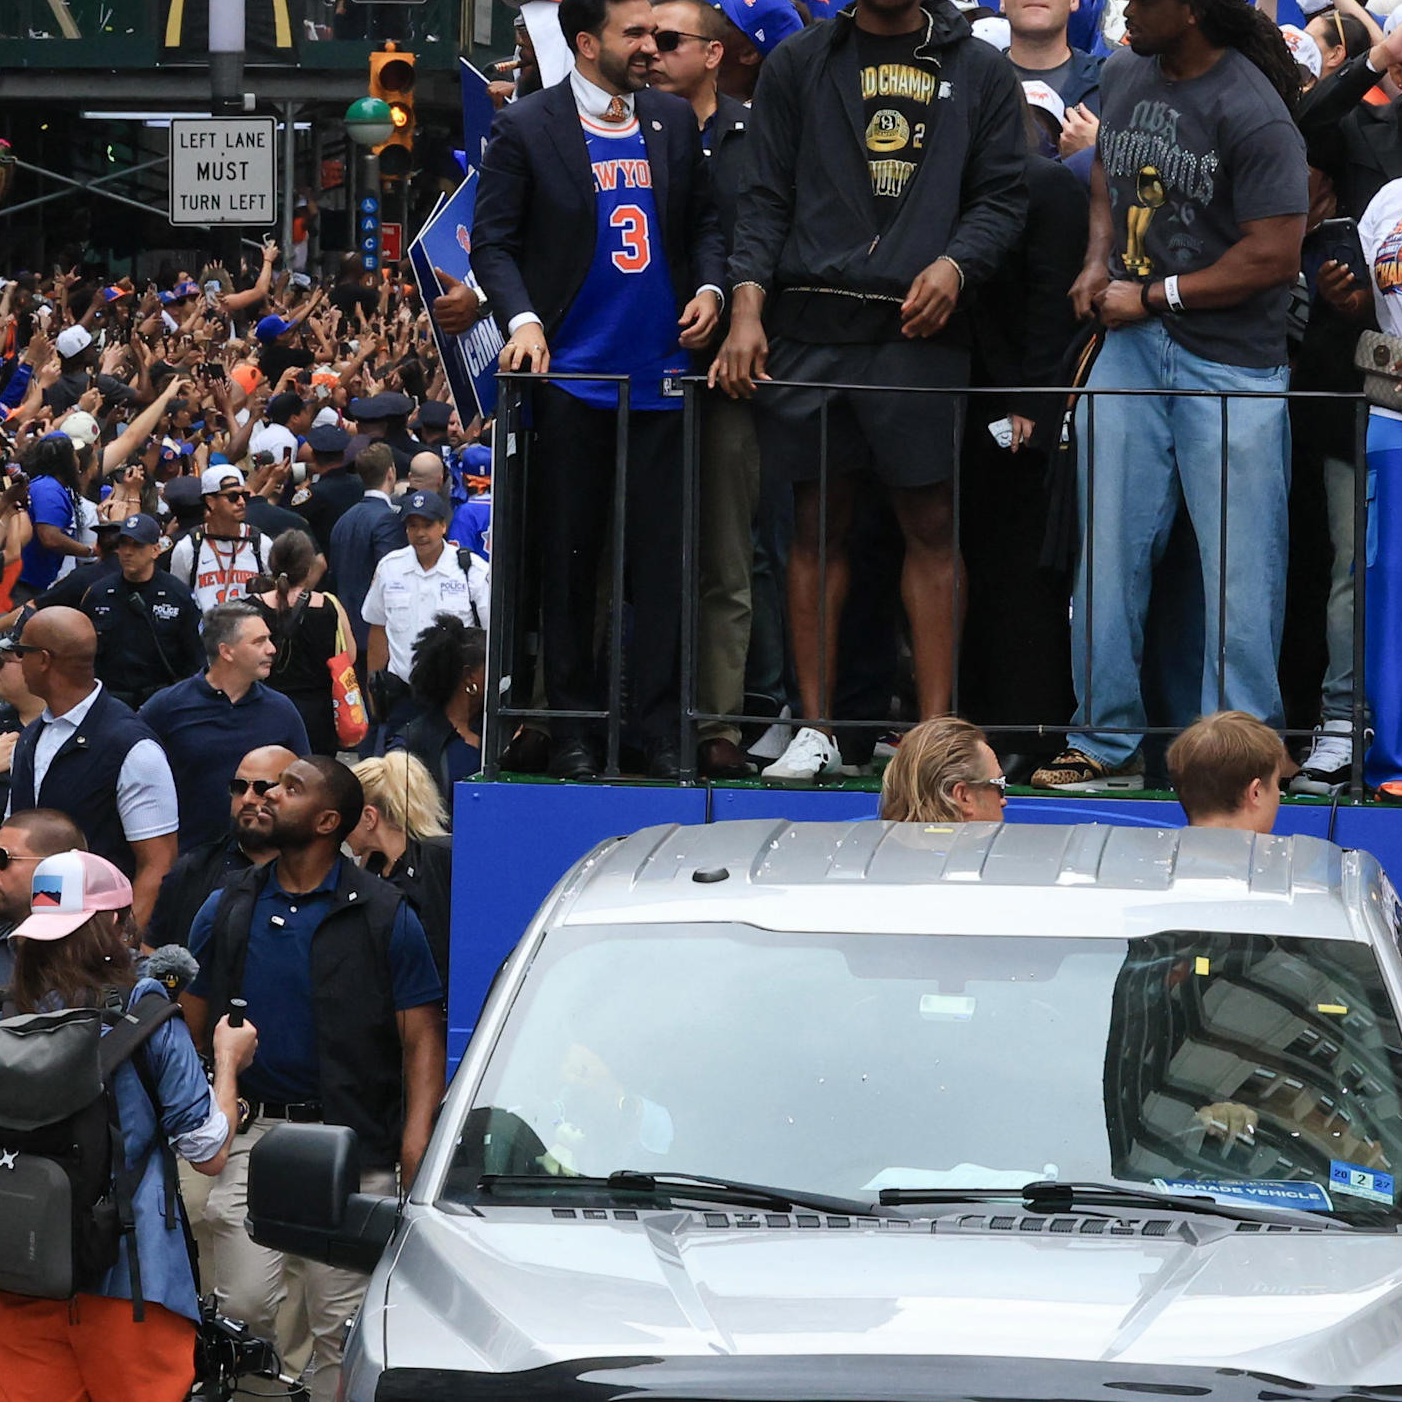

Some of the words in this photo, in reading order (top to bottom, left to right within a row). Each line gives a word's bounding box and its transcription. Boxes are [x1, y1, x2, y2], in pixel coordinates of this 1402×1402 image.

[180, 133, 216, 148] LEFT
[226, 132, 265, 148] LANE
[197, 162, 249, 181] MUST
[180, 195, 220, 210] TURN
[230, 194, 266, 210] LEFT
[365, 220, 373, 229] A
[365, 238, 374, 248] C
[610, 204, 651, 273] 3
[366, 257, 373, 267] E
[366, 277, 373, 286] J
[465, 314, 506, 378] CHAM
[199, 571, 225, 588] NEW
[153, 605, 180, 616] POLICE
[1334, 1169, 1348, 1179] 20
[1357, 1174, 1366, 1186] 2
[1376, 1180, 1391, 1190] 27
[1172, 1183, 1243, 1196] PARADE
[1246, 1188, 1321, 1201] VEHICLE
